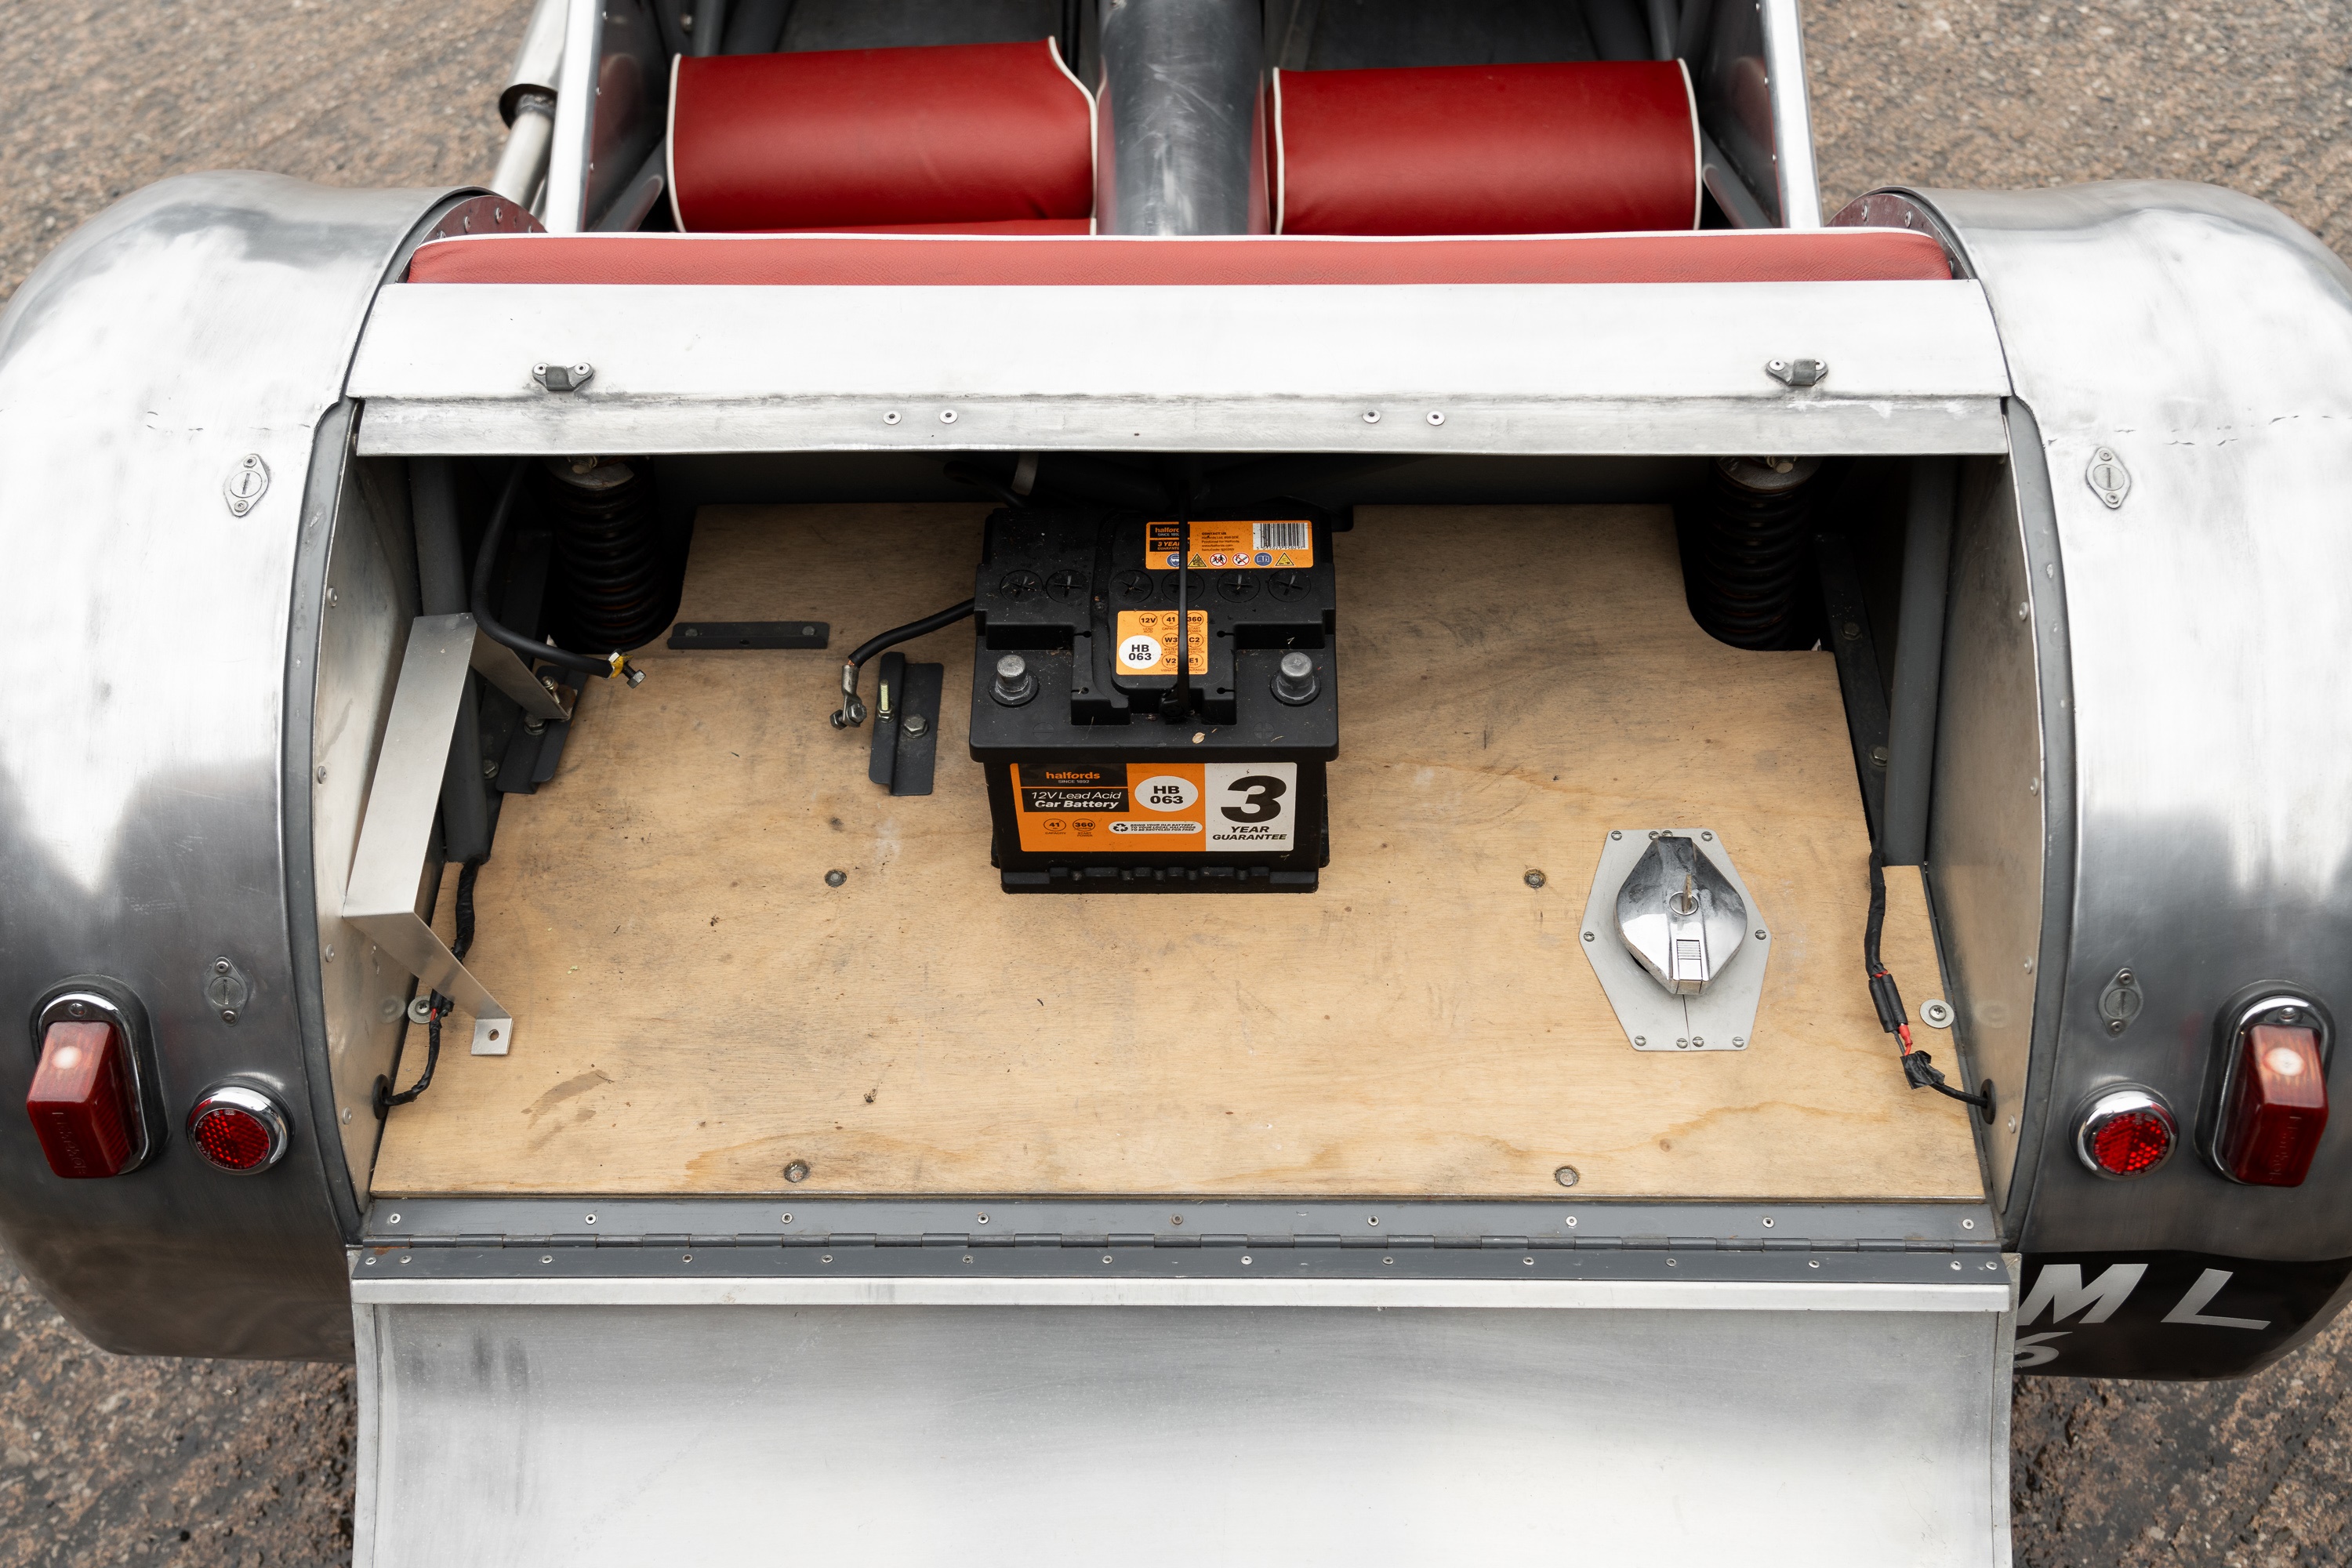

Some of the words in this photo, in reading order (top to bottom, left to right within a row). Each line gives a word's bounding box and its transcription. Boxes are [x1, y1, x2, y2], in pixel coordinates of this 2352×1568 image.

[1153, 786, 1180, 794] HB
[1150, 796, 1184, 804] 063
[1221, 775, 1287, 823] 3
[1063, 800, 1119, 809] Battery
